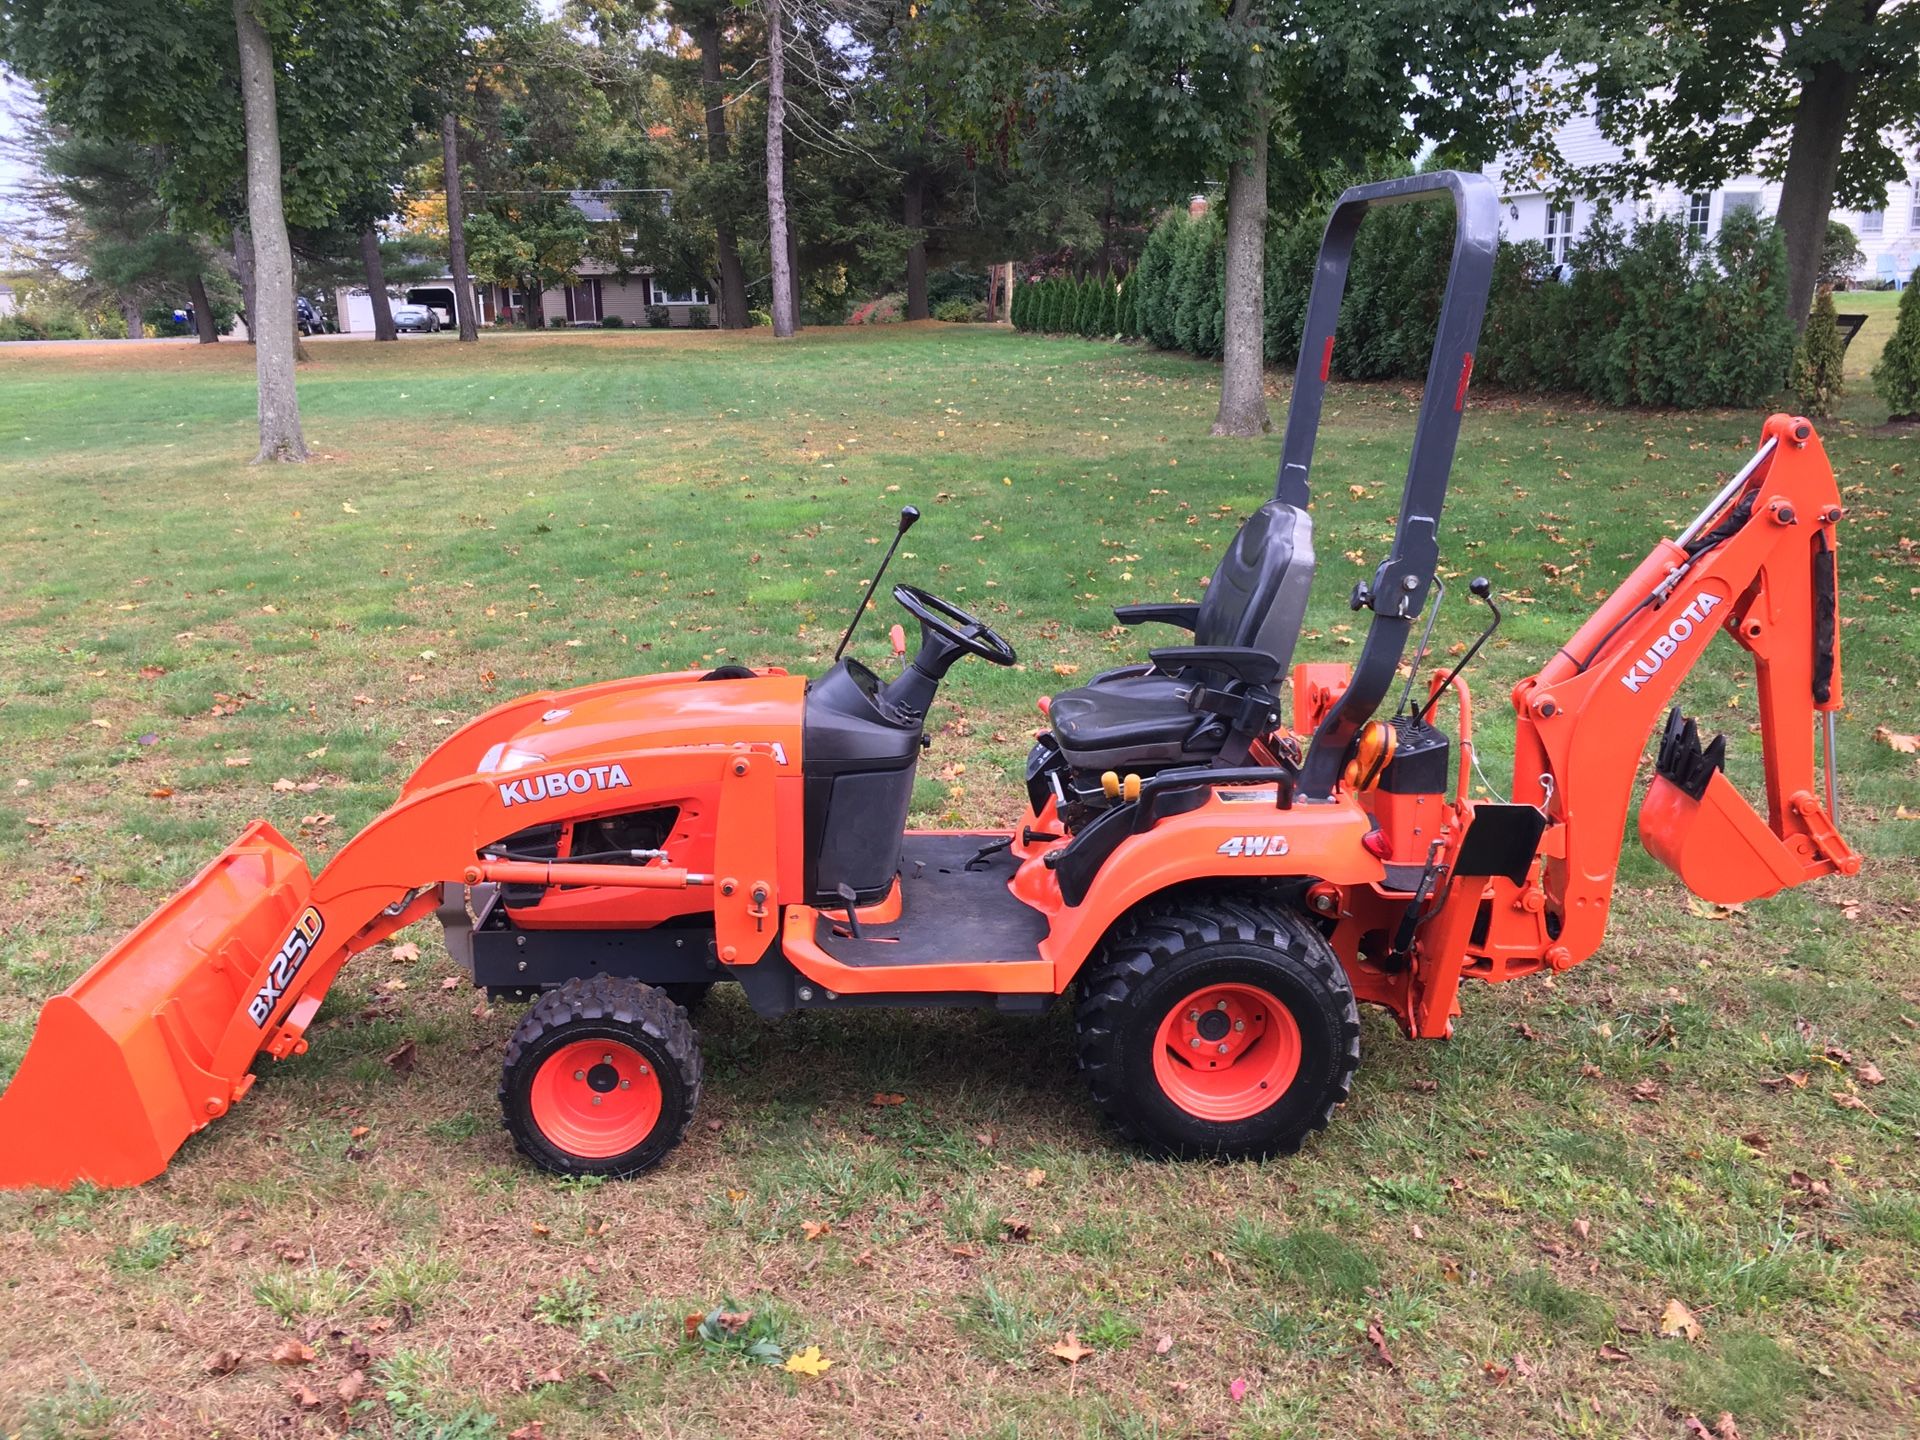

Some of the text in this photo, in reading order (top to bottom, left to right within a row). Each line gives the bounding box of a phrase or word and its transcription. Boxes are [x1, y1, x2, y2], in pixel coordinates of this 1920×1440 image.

[1620, 592, 1723, 694] KUBOTA
[499, 764, 631, 807] KUBOTA
[1216, 835, 1289, 857] 4WD
[247, 906, 325, 1029] BX25D
